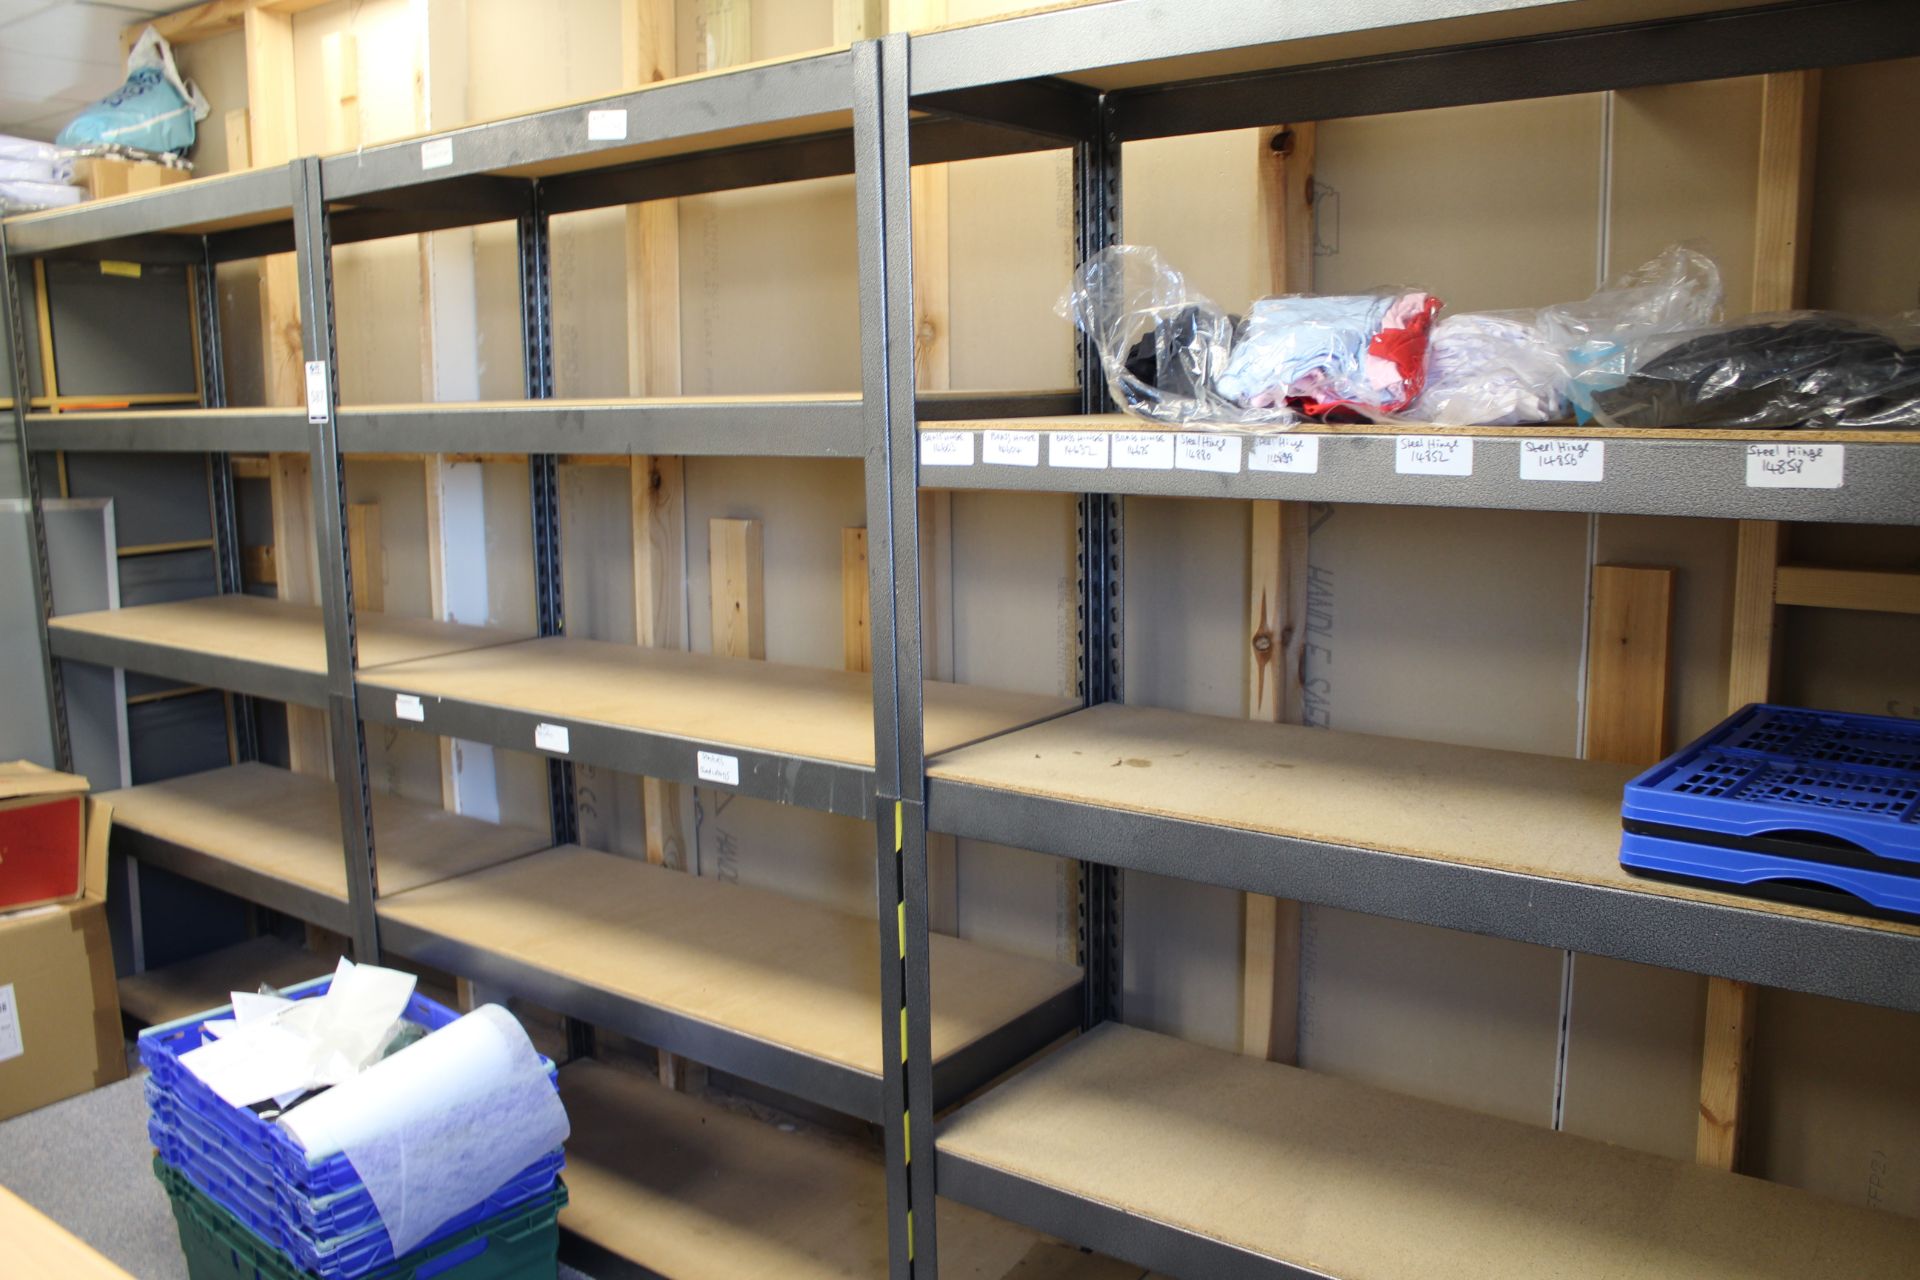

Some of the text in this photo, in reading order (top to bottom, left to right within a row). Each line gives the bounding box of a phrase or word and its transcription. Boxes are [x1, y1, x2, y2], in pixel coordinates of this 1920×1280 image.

[1401, 438, 1459, 453] Steel Hinge
[1525, 441, 1589, 458] Steel Hinge
[1747, 444, 1824, 462] Steel Hinge
[1412, 450, 1450, 463] 14852
[1762, 458, 1804, 474] 14858
